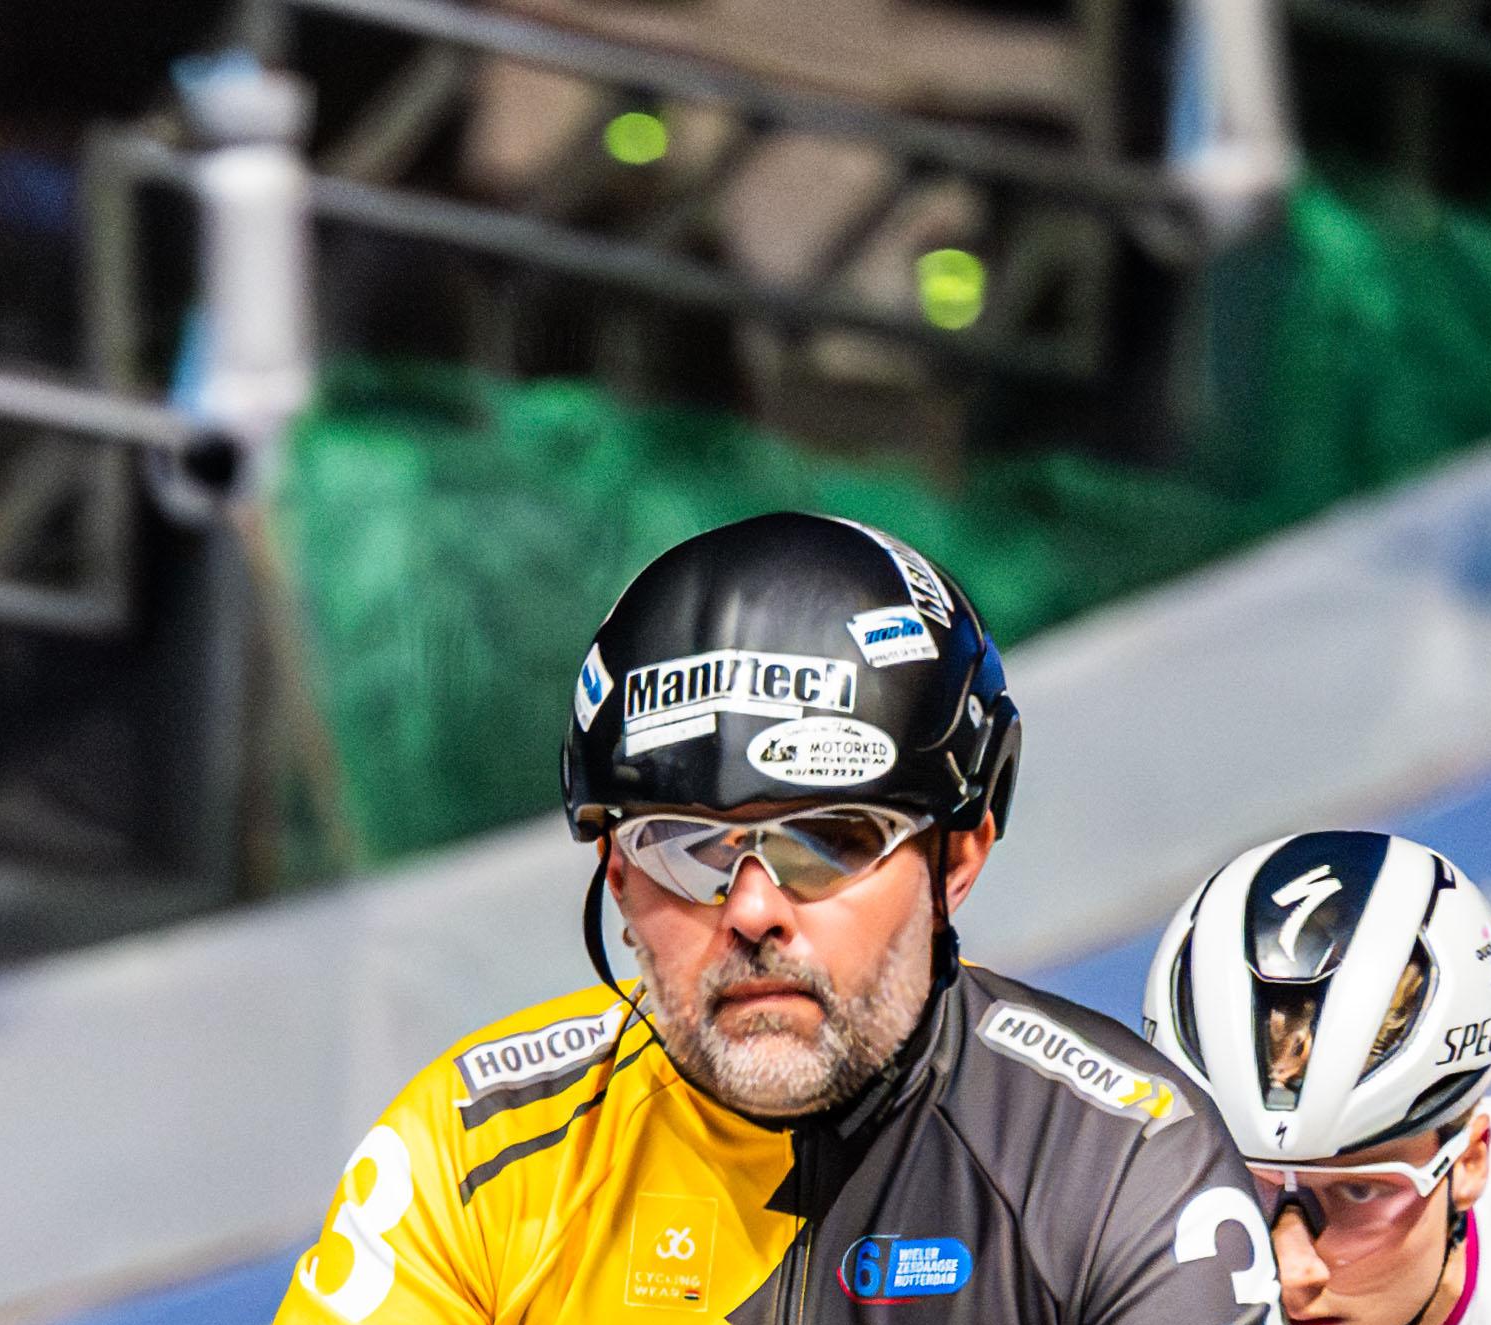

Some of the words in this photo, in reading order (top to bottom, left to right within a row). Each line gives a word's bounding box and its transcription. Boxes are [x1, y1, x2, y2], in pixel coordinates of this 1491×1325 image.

[810, 741, 888, 756] MOTORKID
[474, 1019, 607, 1078] HOUCON
[998, 1014, 1123, 1094] HOUCON
[299, 1126, 413, 1324] 3
